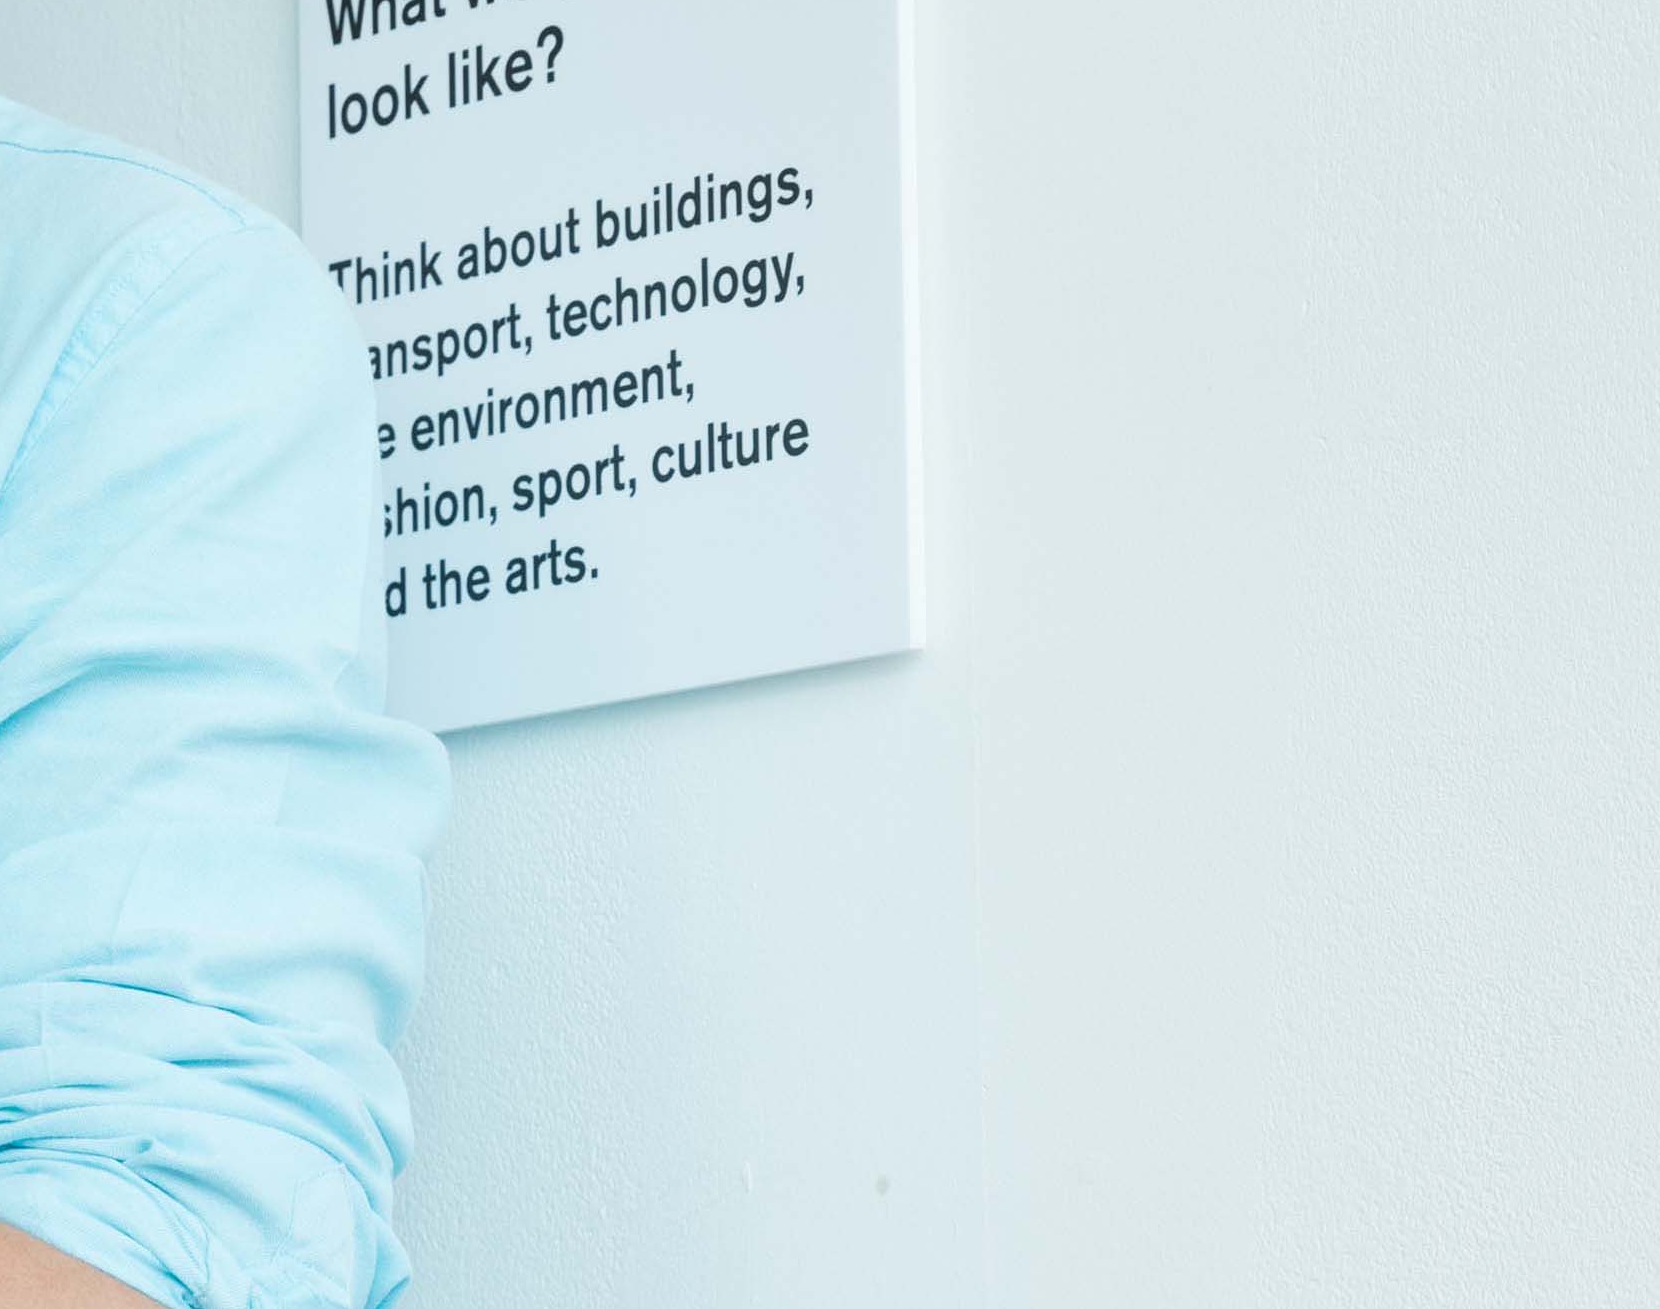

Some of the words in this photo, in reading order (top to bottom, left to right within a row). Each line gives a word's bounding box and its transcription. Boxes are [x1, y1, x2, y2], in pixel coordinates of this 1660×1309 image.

[328, 62, 432, 141] look
[447, 24, 566, 110] like?
[328, 242, 444, 306] Think
[455, 206, 582, 283] about
[595, 166, 814, 251] buildings,
[368, 301, 533, 380] ansport,
[545, 250, 806, 343] technology,
[410, 348, 695, 454] environment,
[512, 442, 638, 520] sport,
[651, 416, 810, 486] culture
[421, 557, 492, 611] the
[505, 536, 600, 596] arts.
